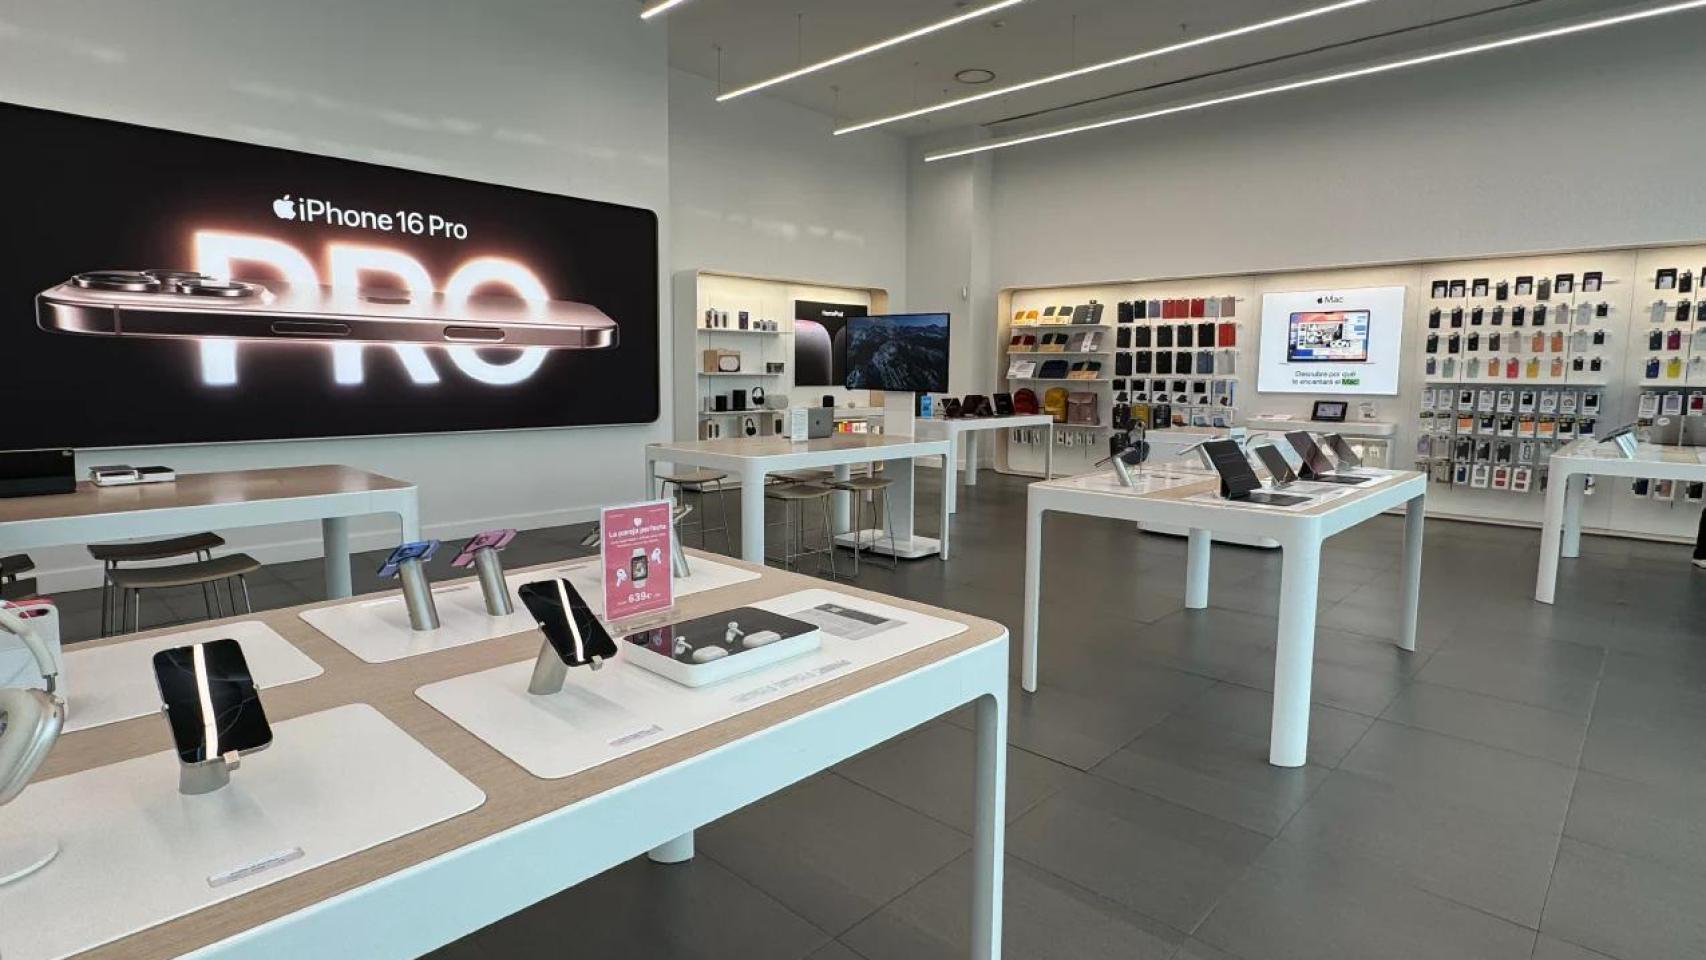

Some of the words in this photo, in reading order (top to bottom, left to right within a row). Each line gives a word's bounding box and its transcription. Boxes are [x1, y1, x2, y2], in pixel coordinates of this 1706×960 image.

[298, 198, 393, 232] iPhone
[395, 209, 424, 234] 16
[429, 216, 468, 240] Pro
[1324, 295, 1344, 304] Mac
[193, 230, 551, 387] PRO
[1328, 371, 1340, 379] por
[608, 530, 618, 538] La
